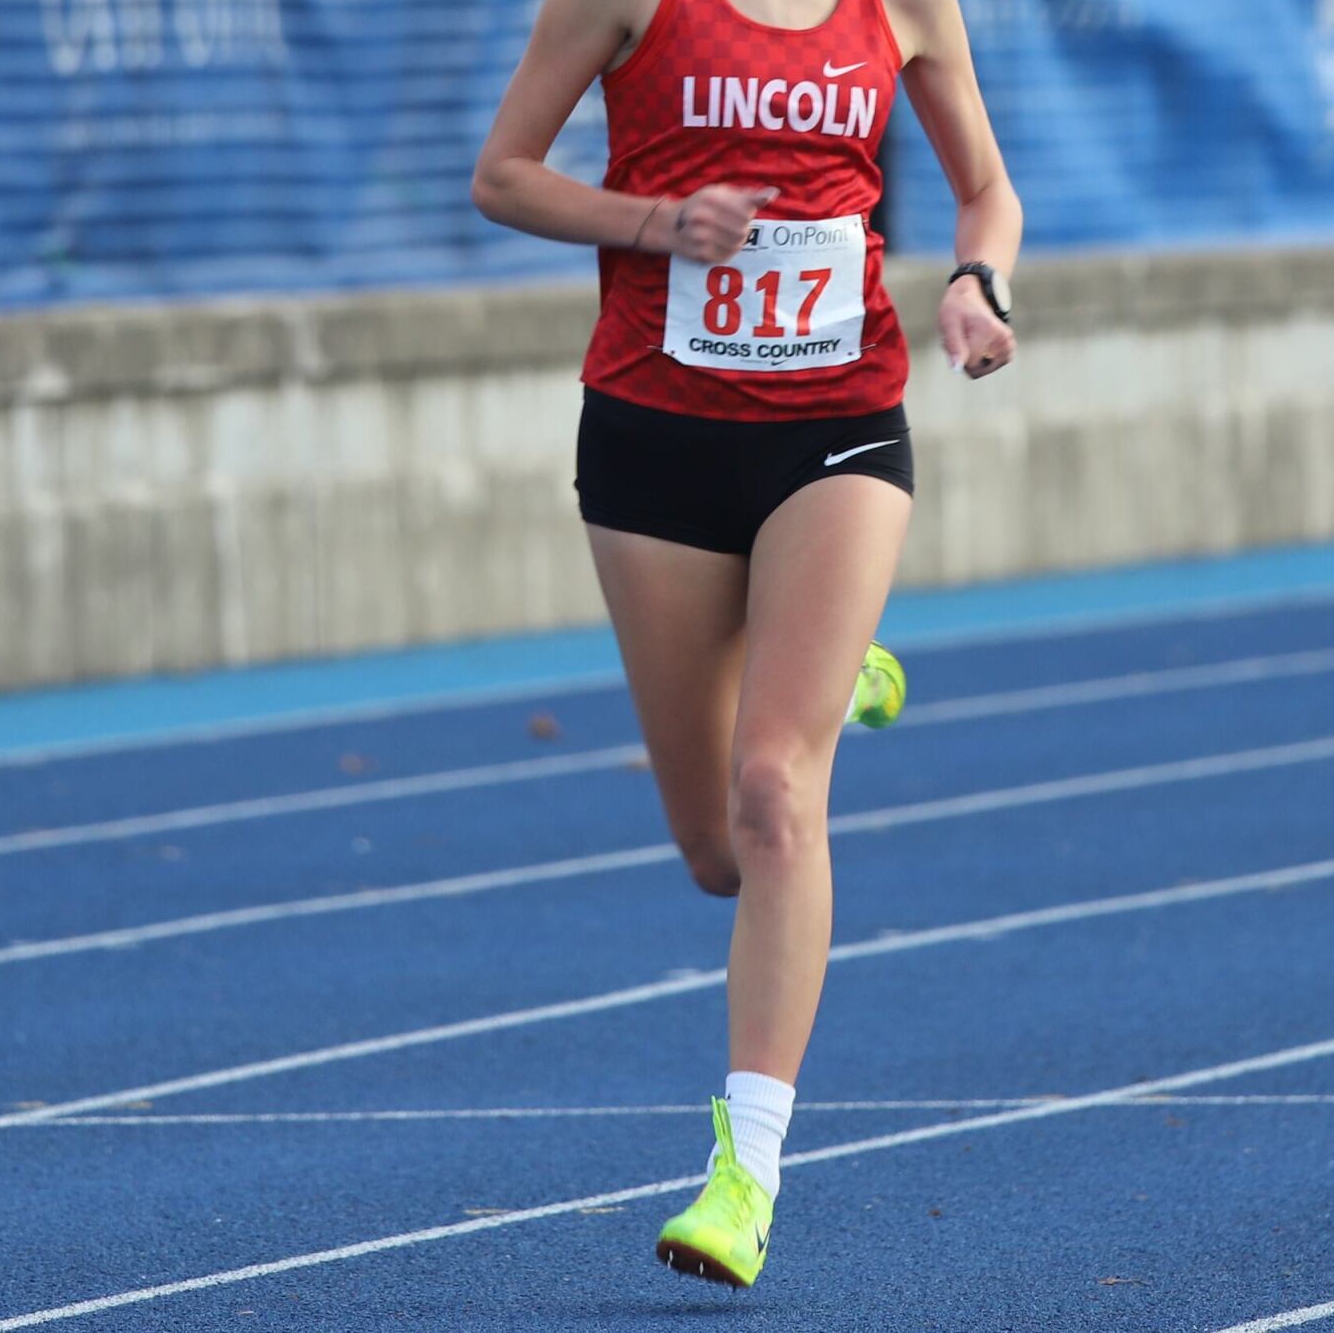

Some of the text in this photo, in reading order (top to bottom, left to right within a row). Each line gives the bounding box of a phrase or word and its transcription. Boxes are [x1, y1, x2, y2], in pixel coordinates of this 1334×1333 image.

[682, 75, 878, 139] LINCOLN
[772, 225, 849, 247] OnPoint
[703, 265, 832, 338] 817
[689, 337, 842, 359] CROSS COUNTRY
